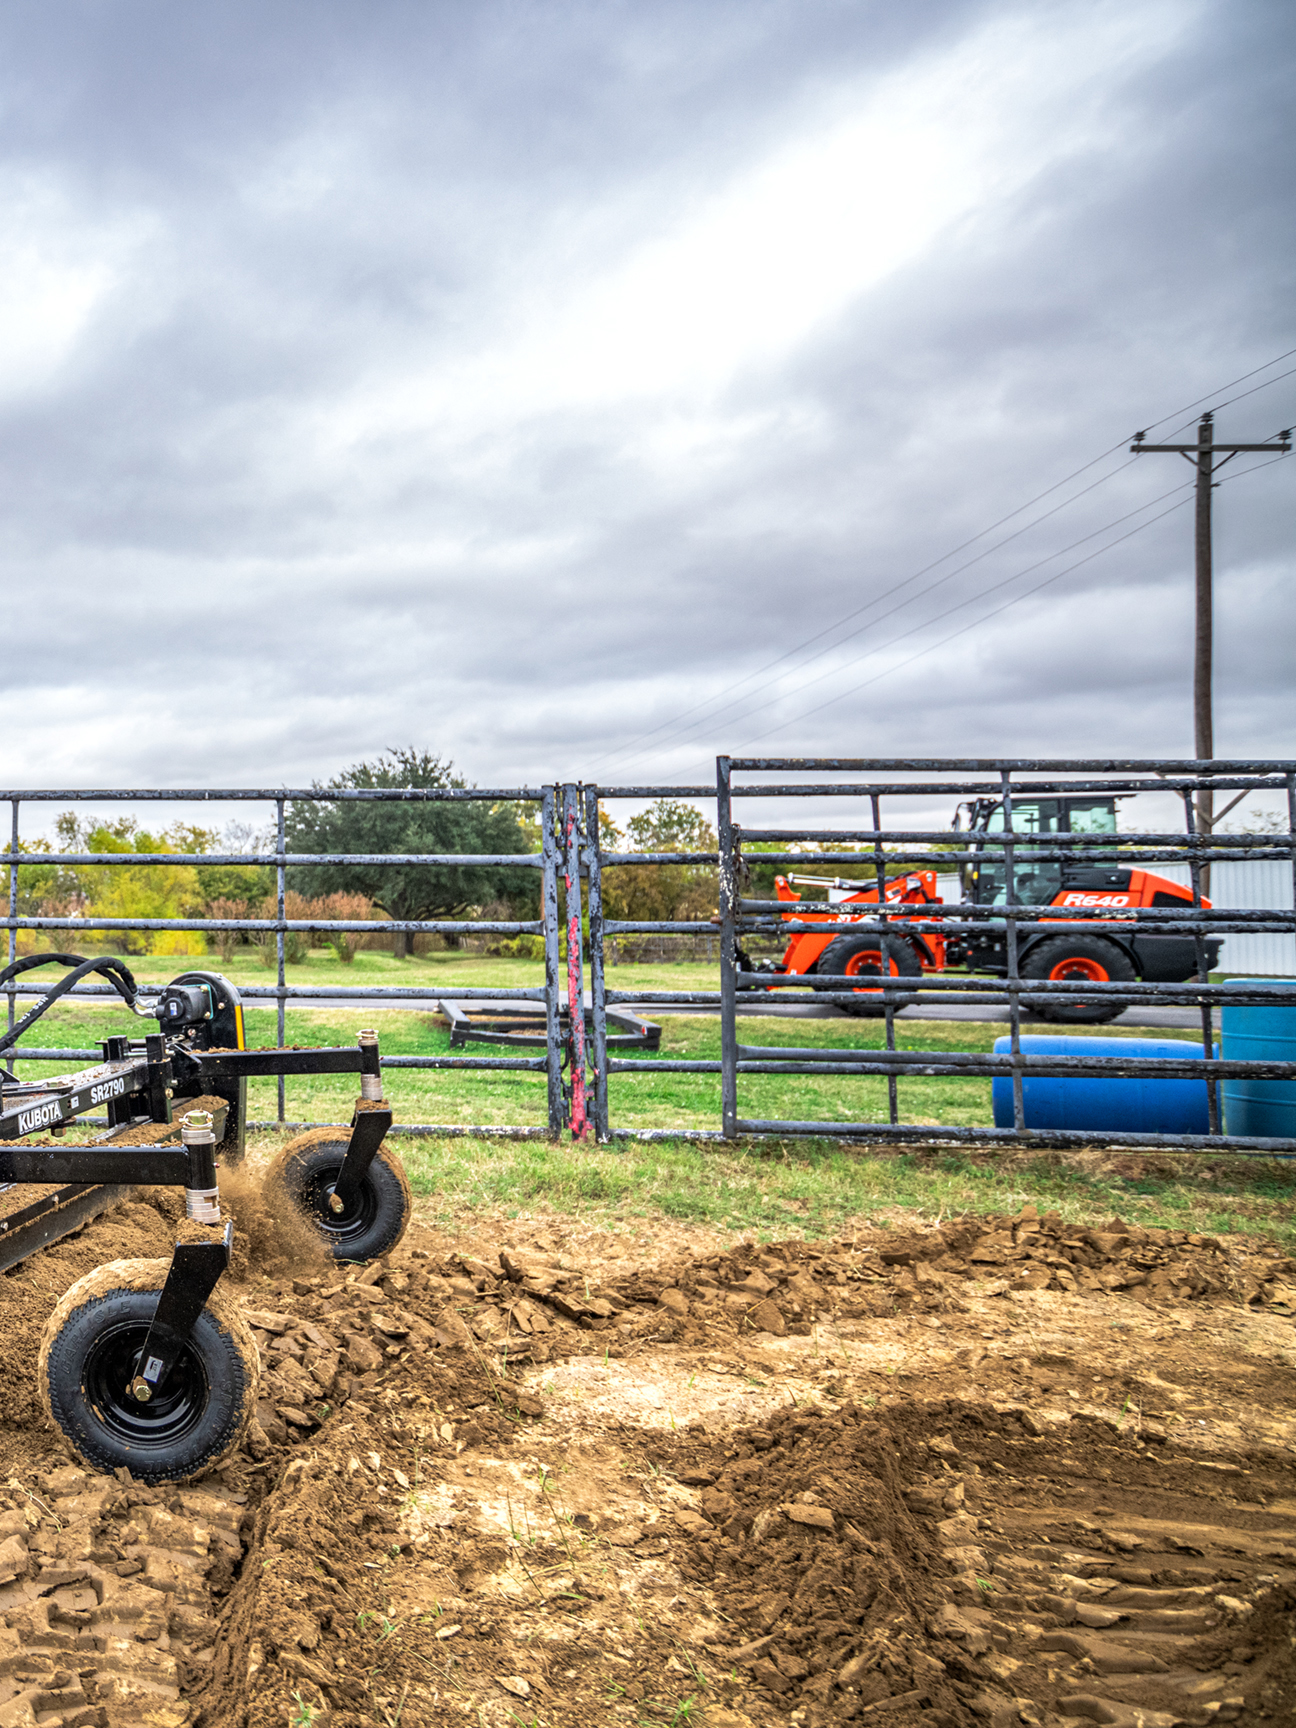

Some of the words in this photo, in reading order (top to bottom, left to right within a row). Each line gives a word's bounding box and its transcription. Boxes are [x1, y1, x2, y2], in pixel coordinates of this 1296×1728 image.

[1063, 893, 1130, 907] R640
[90, 1077, 125, 1104] SR2790
[18, 1100, 64, 1136] KUBOTA
[61, 1300, 131, 1374] CARLISLE
